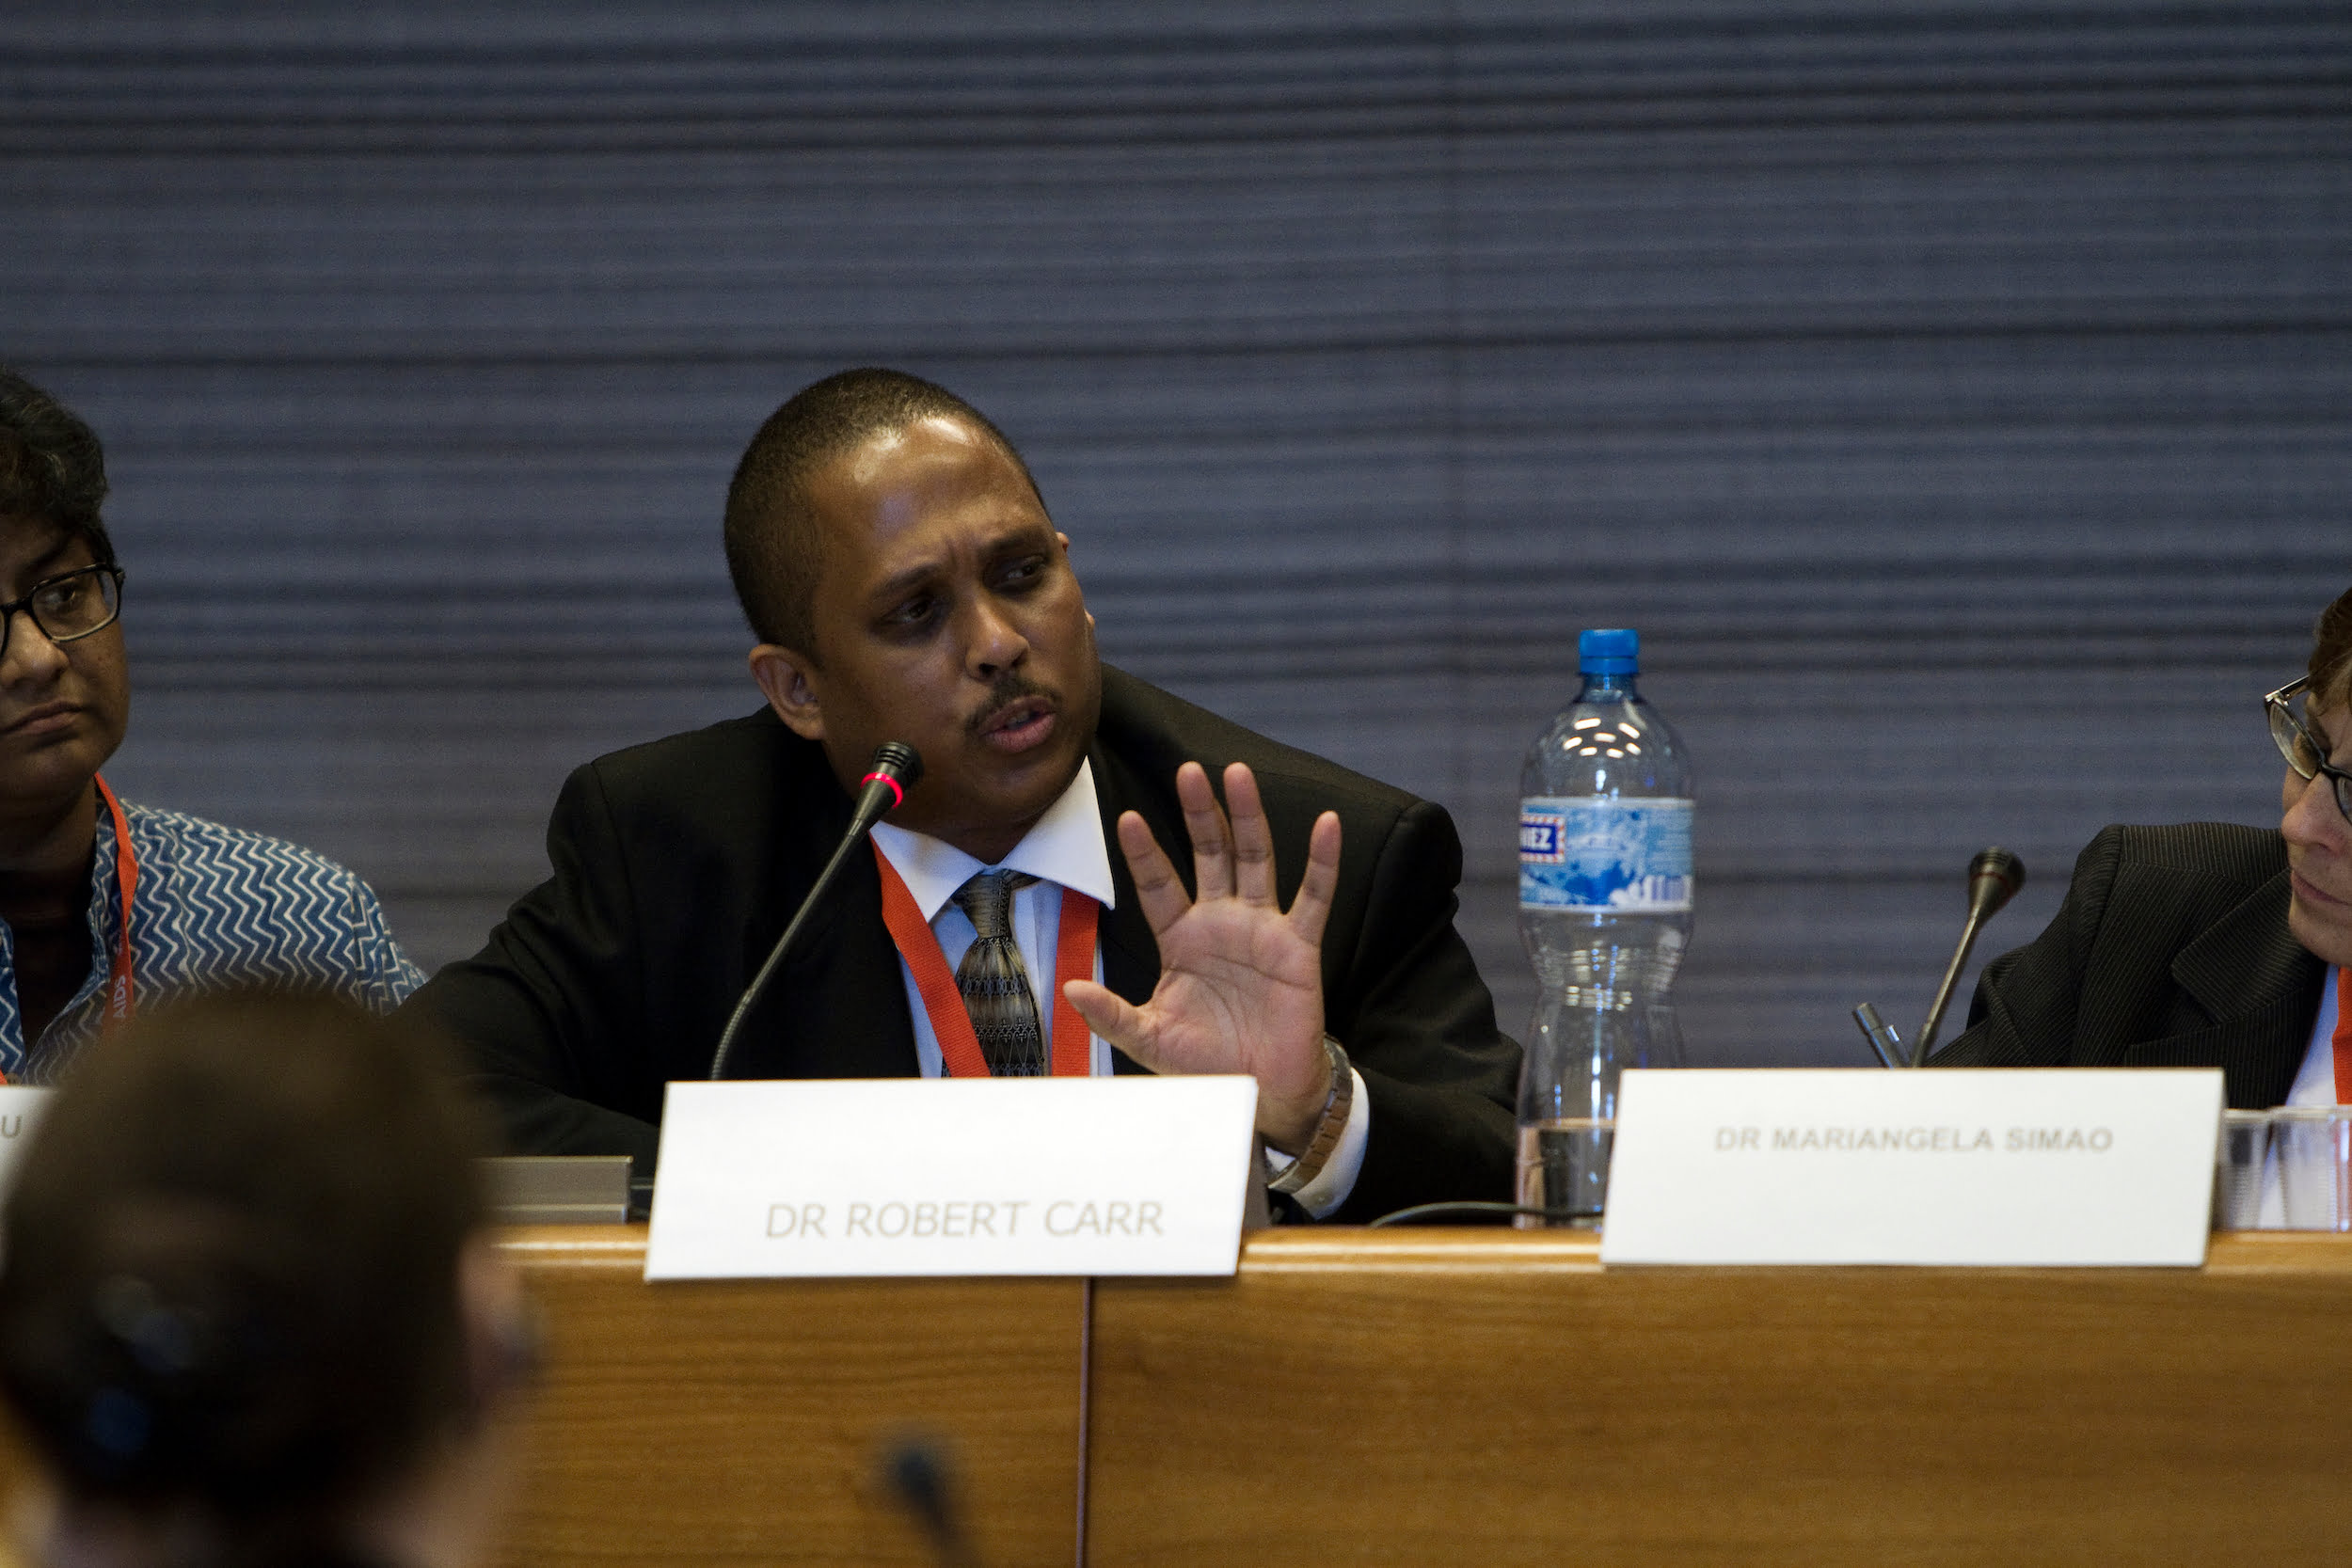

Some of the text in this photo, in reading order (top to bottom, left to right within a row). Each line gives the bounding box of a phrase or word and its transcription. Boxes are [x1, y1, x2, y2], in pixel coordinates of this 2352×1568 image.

[1714, 1127, 2114, 1153] DR MARIANGELA SIMAO
[765, 1199, 1165, 1240] DR ROBERT CARR
